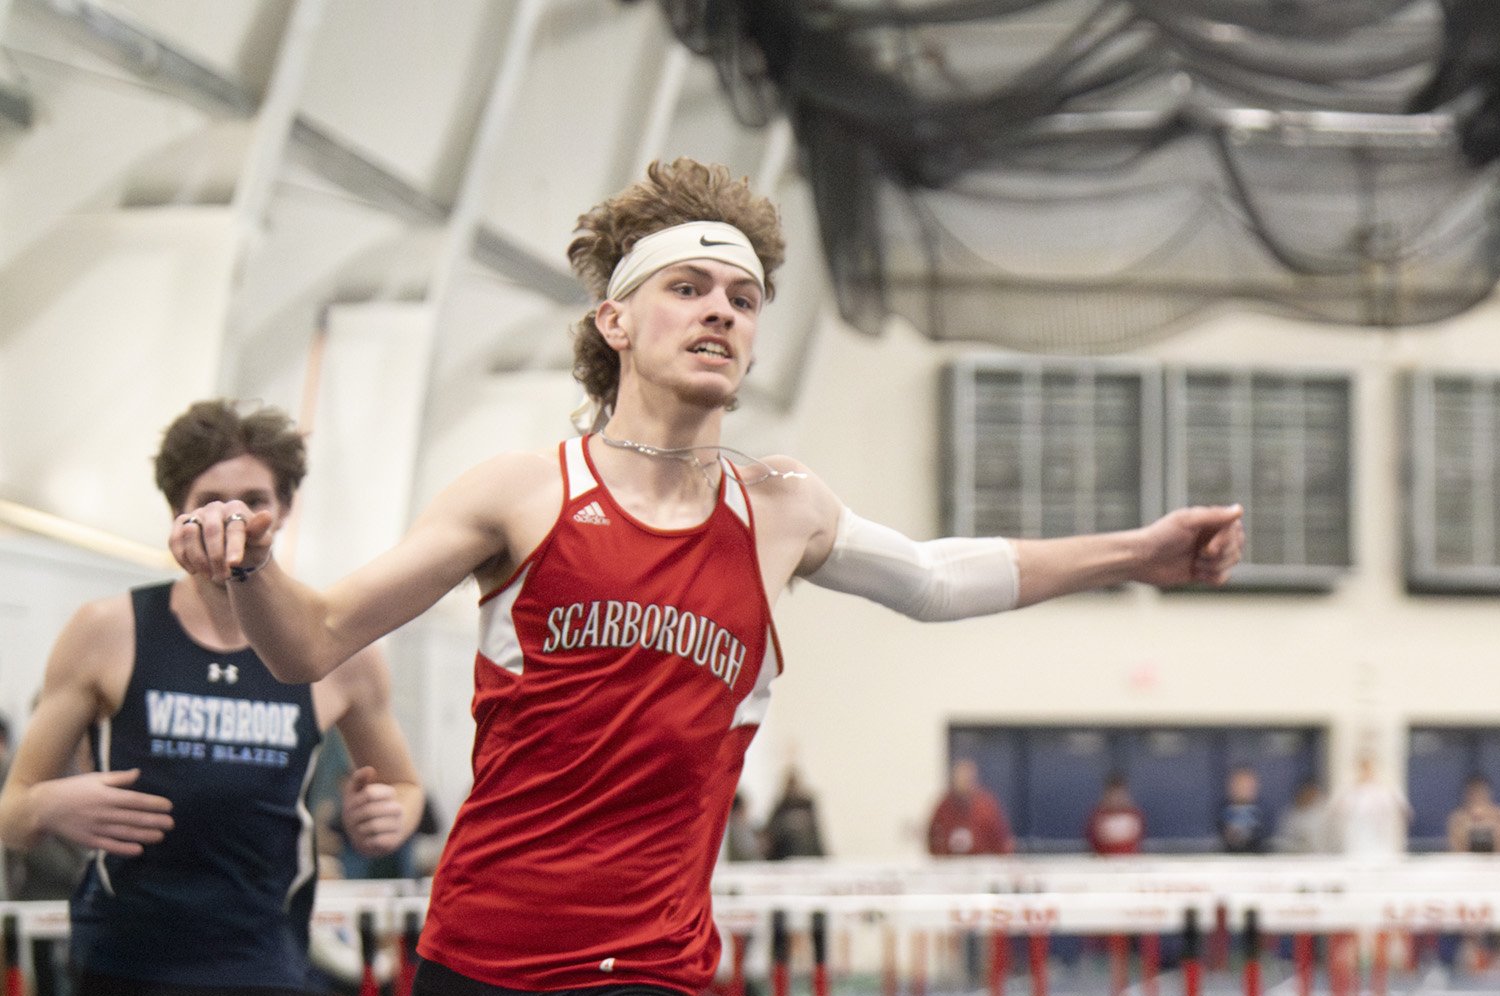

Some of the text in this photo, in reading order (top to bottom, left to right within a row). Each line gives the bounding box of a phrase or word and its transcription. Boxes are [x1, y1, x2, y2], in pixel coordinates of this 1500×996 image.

[543, 600, 747, 691] SCARBOROUGH
[146, 689, 300, 749] WESTBROOK
[151, 739, 289, 768] BLUE BLAZES
[949, 905, 1061, 925] USM
